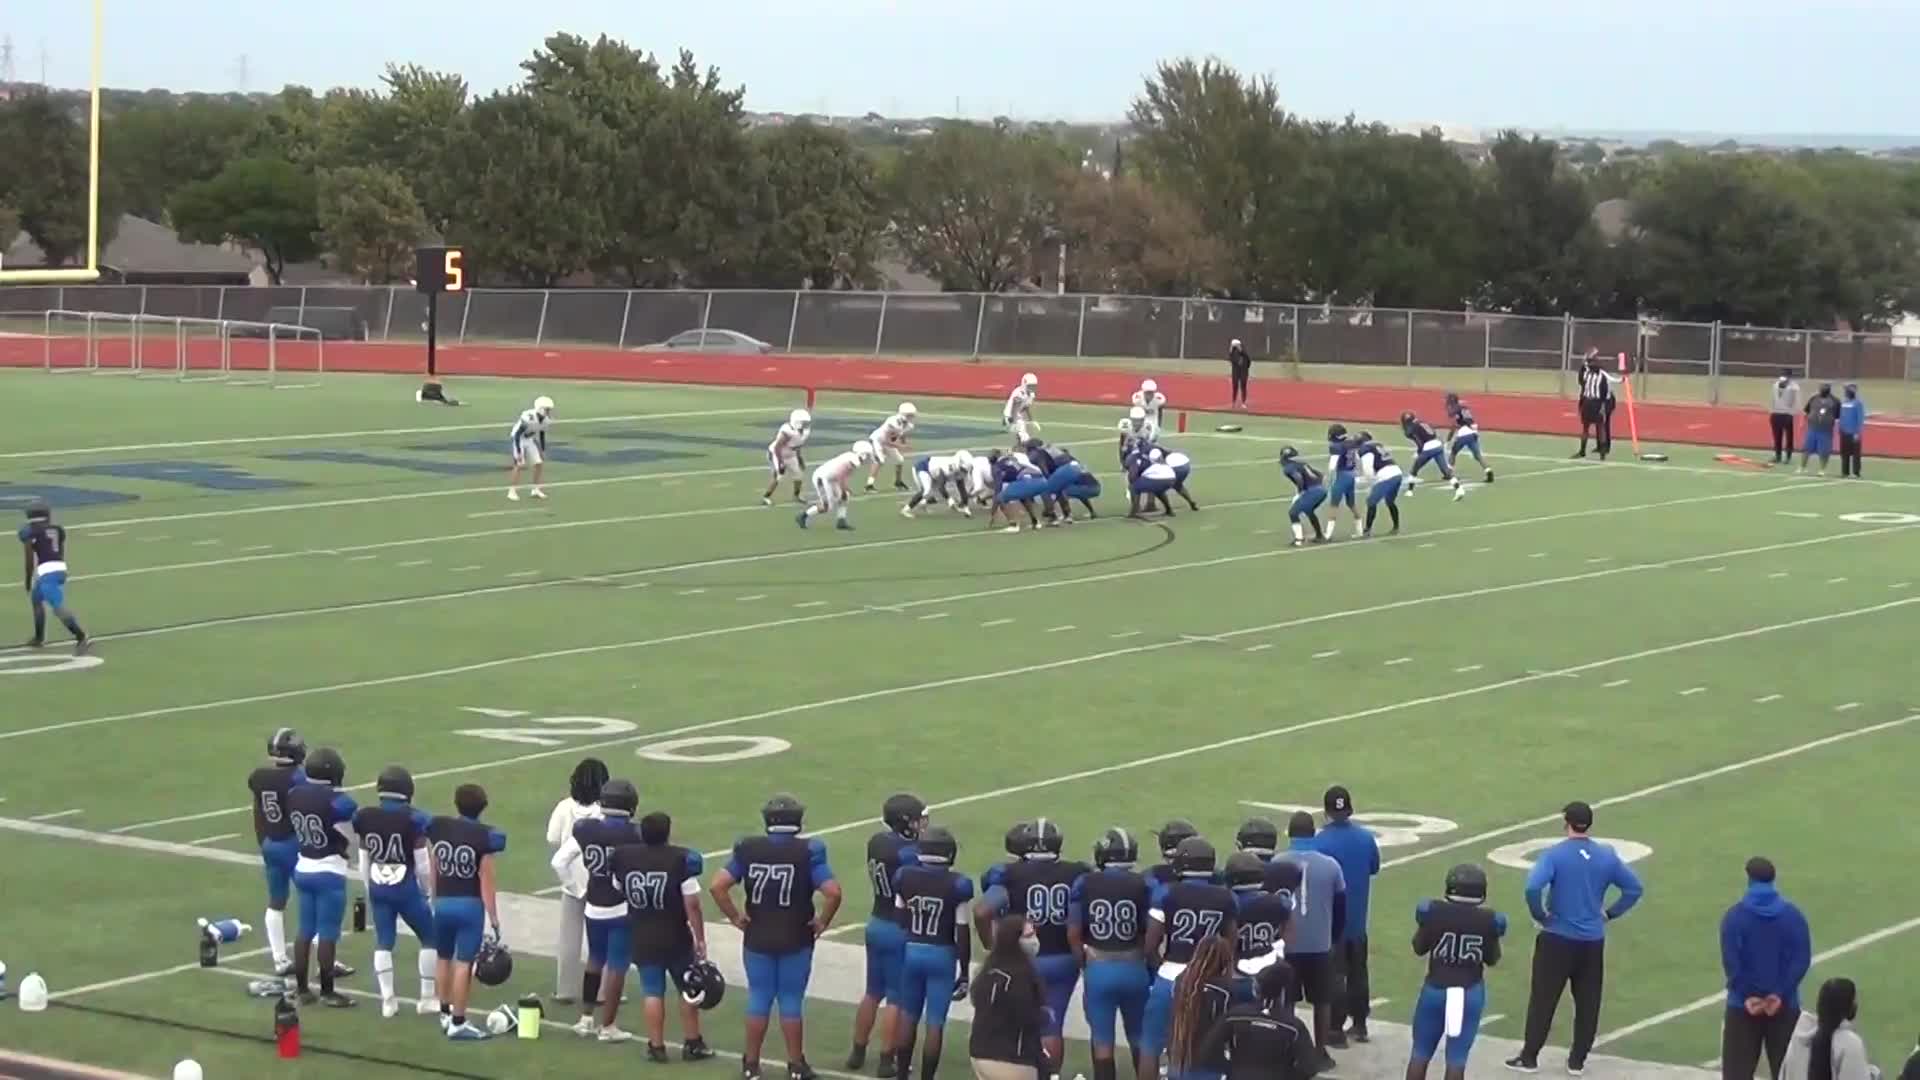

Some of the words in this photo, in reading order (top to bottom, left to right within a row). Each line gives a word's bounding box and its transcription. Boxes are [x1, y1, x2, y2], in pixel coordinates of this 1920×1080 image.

[445, 250, 462, 290] 5
[261, 790, 283, 823] 5
[1335, 798, 1345, 810] S
[585, 844, 617, 877] 2
[624, 870, 668, 910] 67
[749, 863, 795, 906] 77
[1026, 883, 1071, 925] 99
[907, 895, 944, 936] 17
[1089, 898, 1138, 941] 38
[1171, 908, 1224, 945] 27
[1433, 931, 1484, 963] 45
